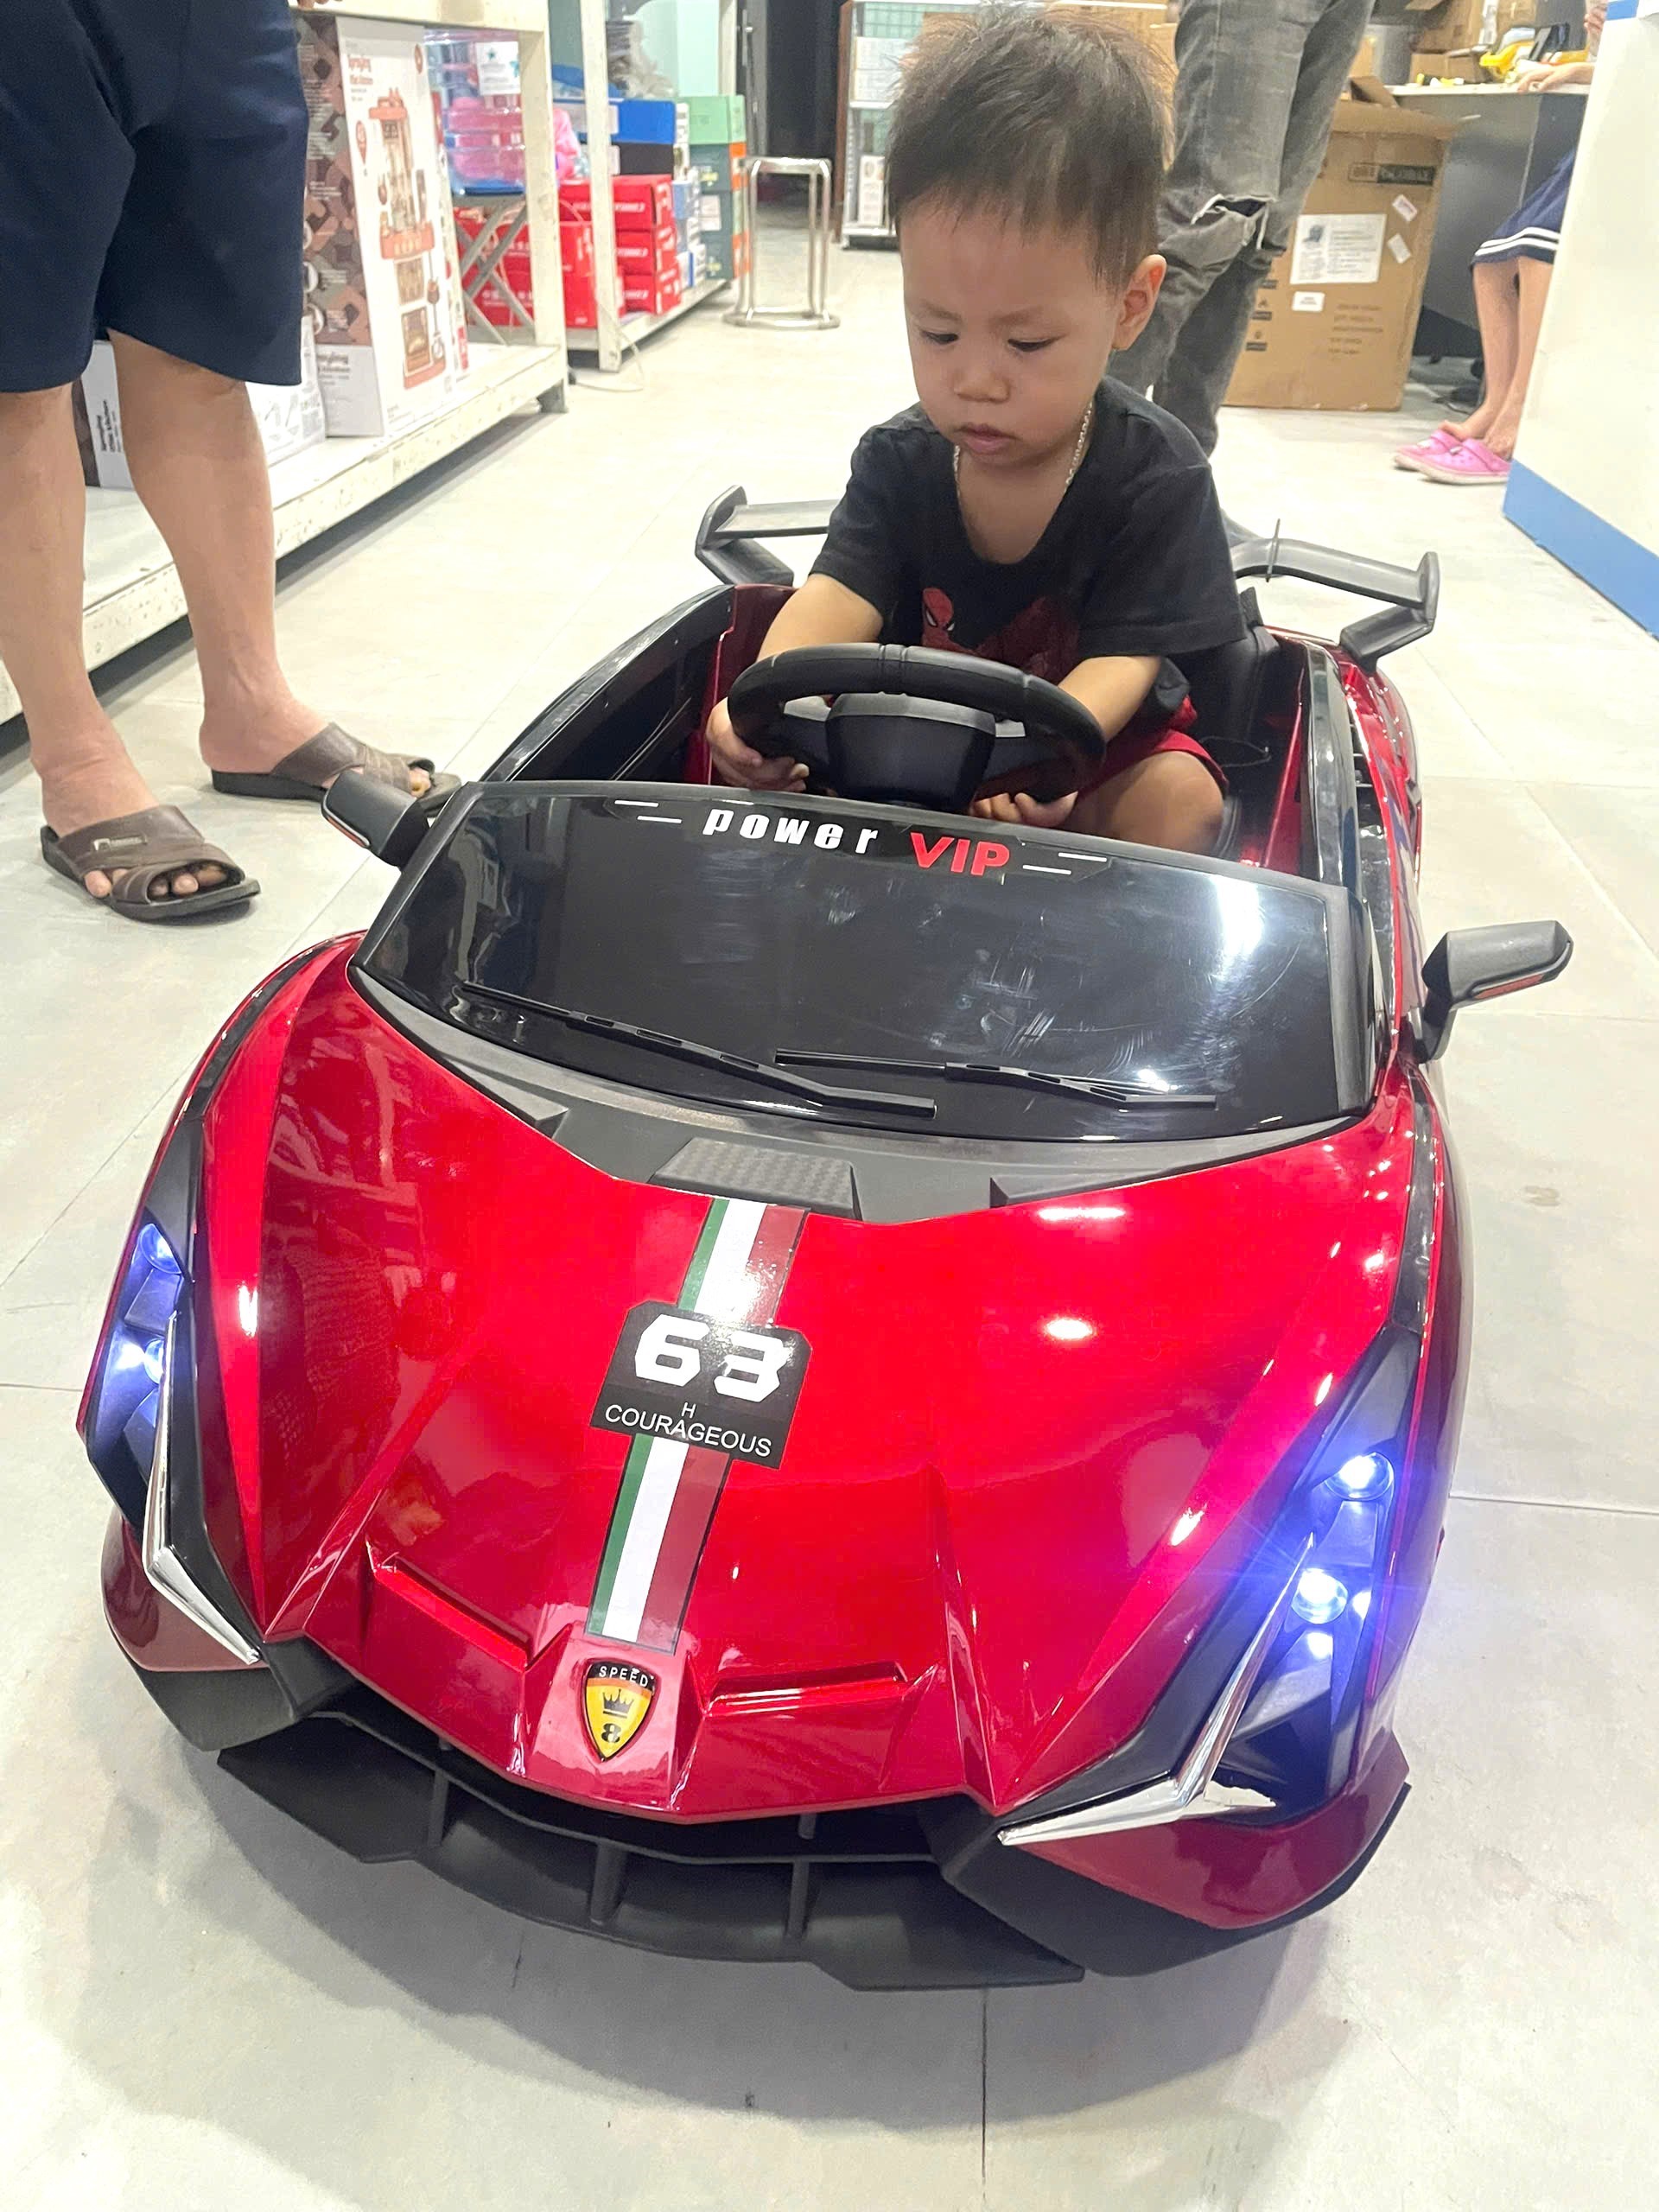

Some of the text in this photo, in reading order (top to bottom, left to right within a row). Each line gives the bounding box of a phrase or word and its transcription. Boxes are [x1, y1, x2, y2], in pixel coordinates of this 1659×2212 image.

[702, 810, 1009, 876] power VIP
[682, 1402, 696, 1419] H
[605, 1404, 772, 1457] COURAGEOUS
[599, 1666, 649, 1687] SPEED
